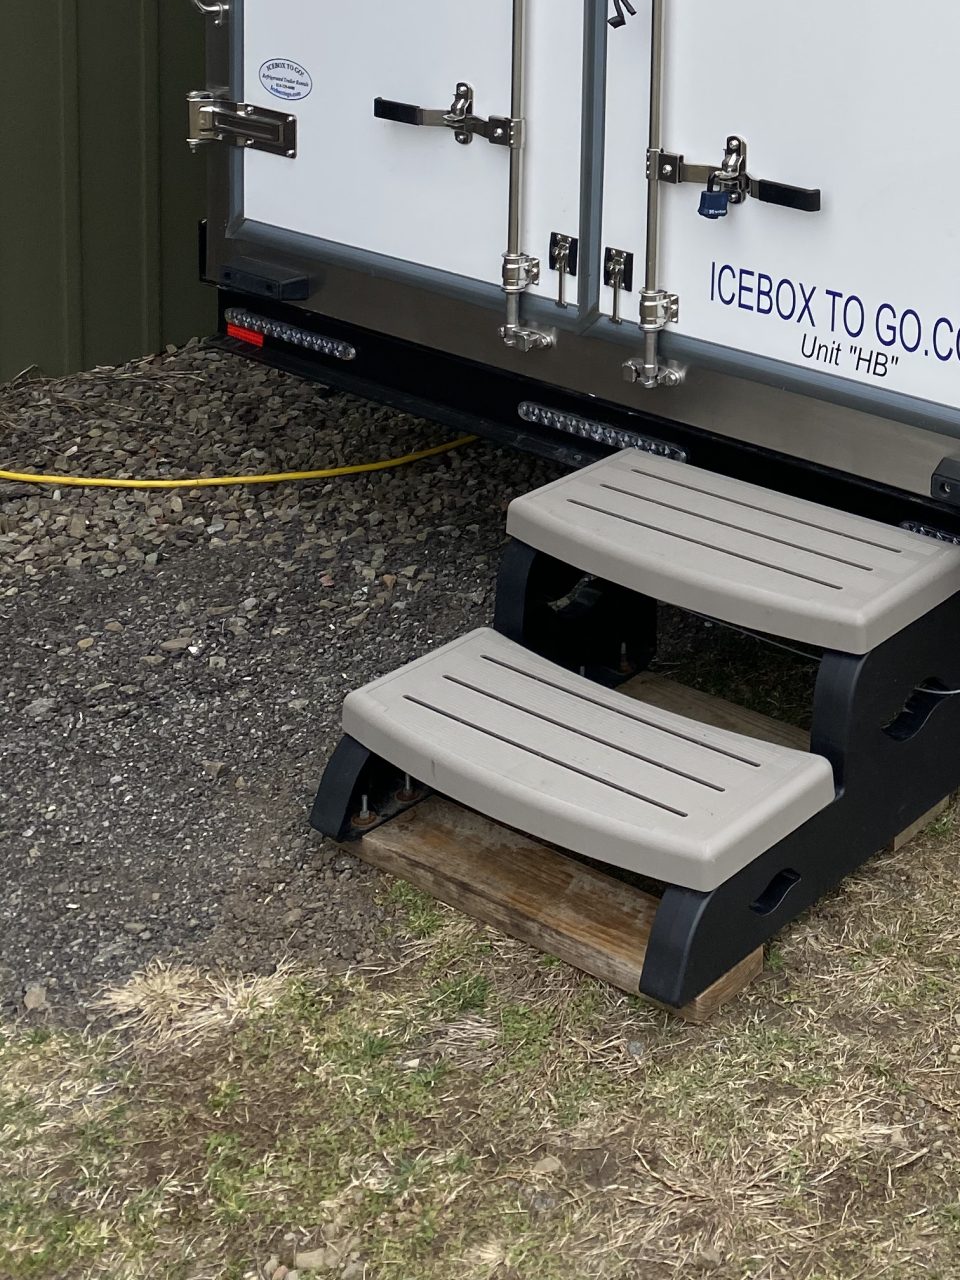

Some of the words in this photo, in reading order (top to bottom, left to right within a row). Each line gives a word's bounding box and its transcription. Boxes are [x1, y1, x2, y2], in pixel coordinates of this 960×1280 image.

[710, 261, 817, 328] ICEBOX
[825, 289, 865, 338] TO
[801, 333, 842, 366] Unit
[849, 345, 899, 378] "HB"
